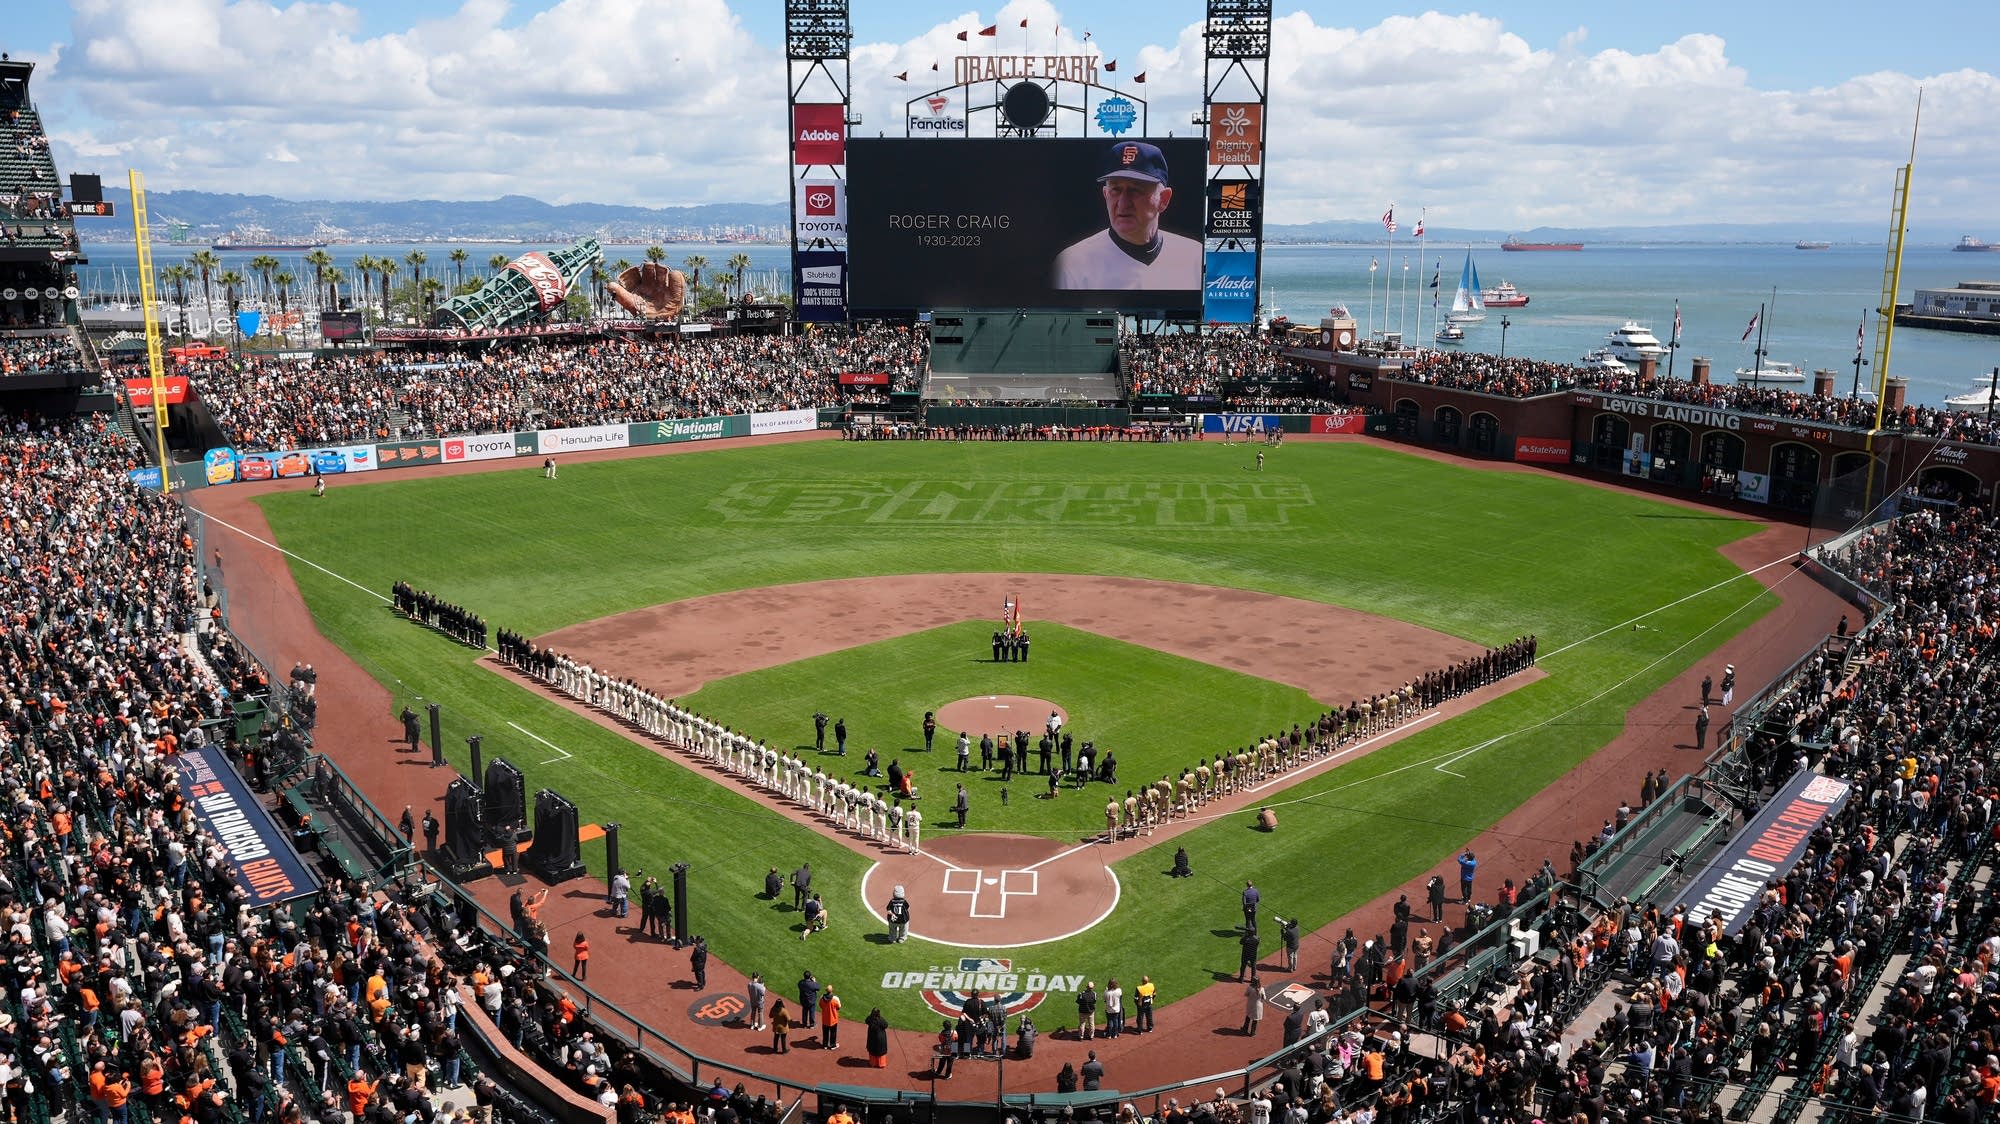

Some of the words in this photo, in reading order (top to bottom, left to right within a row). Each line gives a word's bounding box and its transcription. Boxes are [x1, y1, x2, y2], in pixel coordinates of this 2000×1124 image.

[955, 55, 1035, 85] ORACLE
[1043, 55, 1099, 86] PARK
[1101, 104, 1132, 115] coupa
[910, 117, 964, 130] Fanatics
[800, 129, 839, 141] Adobe
[1216, 140, 1253, 152] Dignity
[1217, 152, 1252, 162] Health
[71, 204, 82, 213] WE
[83, 204, 96, 213] ARE
[1213, 211, 1252, 219] CACHE
[799, 222, 843, 231] TOYOTA
[889, 215, 950, 229] ROGER
[957, 215, 1010, 229] CRAIG
[1214, 219, 1251, 227] CREEK
[918, 235, 981, 246] 1930-2023
[807, 271, 837, 279] StubHub
[1206, 274, 1254, 290] Alaska
[803, 288, 818, 297] 100%
[818, 288, 841, 297] VERIFIED
[802, 297, 821, 306] GIANTS
[821, 297, 843, 306] TICKETS
[1653, 404, 1741, 430] LANDING
[673, 420, 724, 435] National
[1218, 416, 1265, 432] VISA
[561, 433, 603, 446] Hanwha
[605, 432, 624, 442] Life
[701, 432, 721, 440] Rental
[468, 441, 512, 453] TOYOTA
[516, 446, 532, 455] 354
[1934, 446, 1968, 459] Alaska
[1575, 455, 1587, 464] 365
[198, 792, 237, 813] SAN
[1777, 799, 1829, 828] PARK
[208, 808, 270, 861] FRANCISCO
[1746, 822, 1808, 863] ORACLE
[1731, 858, 1776, 877] TO
[240, 858, 295, 899] GIANTS
[1688, 872, 1765, 930] WELCOME
[881, 972, 1018, 991] OPENING
[1026, 974, 1086, 992] DAY
